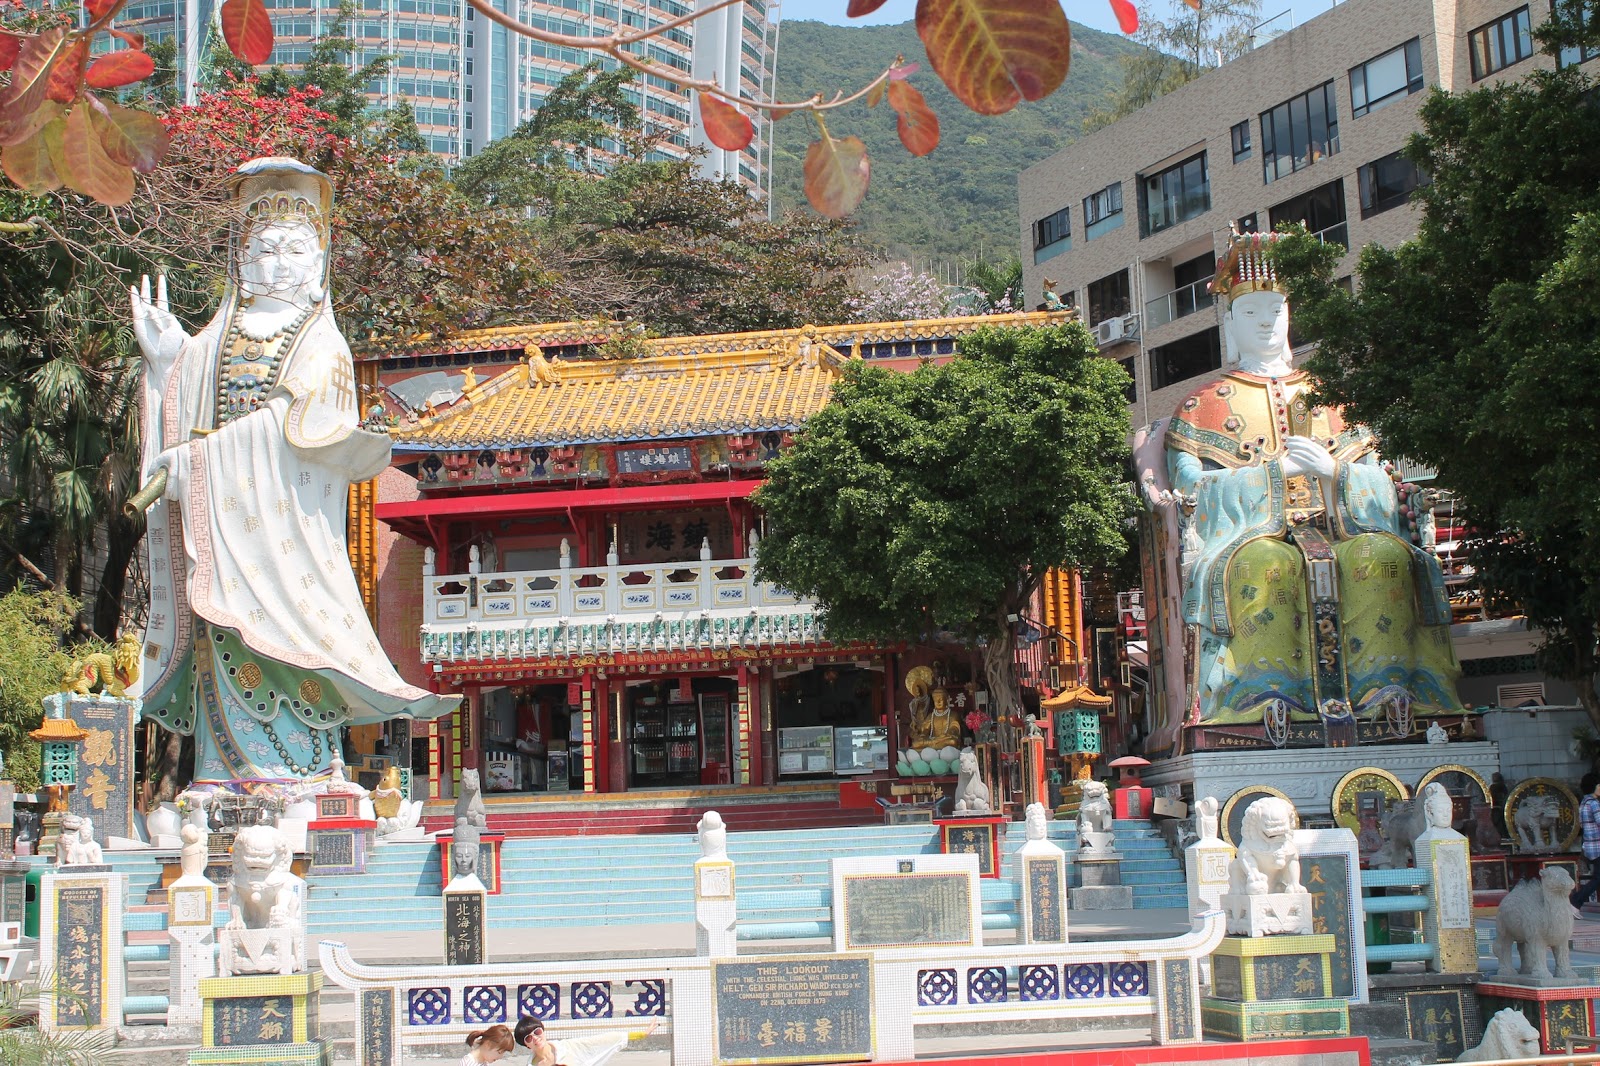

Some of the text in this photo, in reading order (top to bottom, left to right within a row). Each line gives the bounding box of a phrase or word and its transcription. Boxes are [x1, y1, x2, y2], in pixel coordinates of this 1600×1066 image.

[82, 726, 117, 810] 觀音
[456, 903, 472, 959] 北海之神
[749, 984, 764, 992] GEN
[765, 983, 777, 991] SIR
[778, 982, 809, 991] RICHARD
[810, 982, 829, 990] WARD
[756, 965, 829, 976] THIS LOOKOUT
[257, 999, 287, 1041] 天獅
